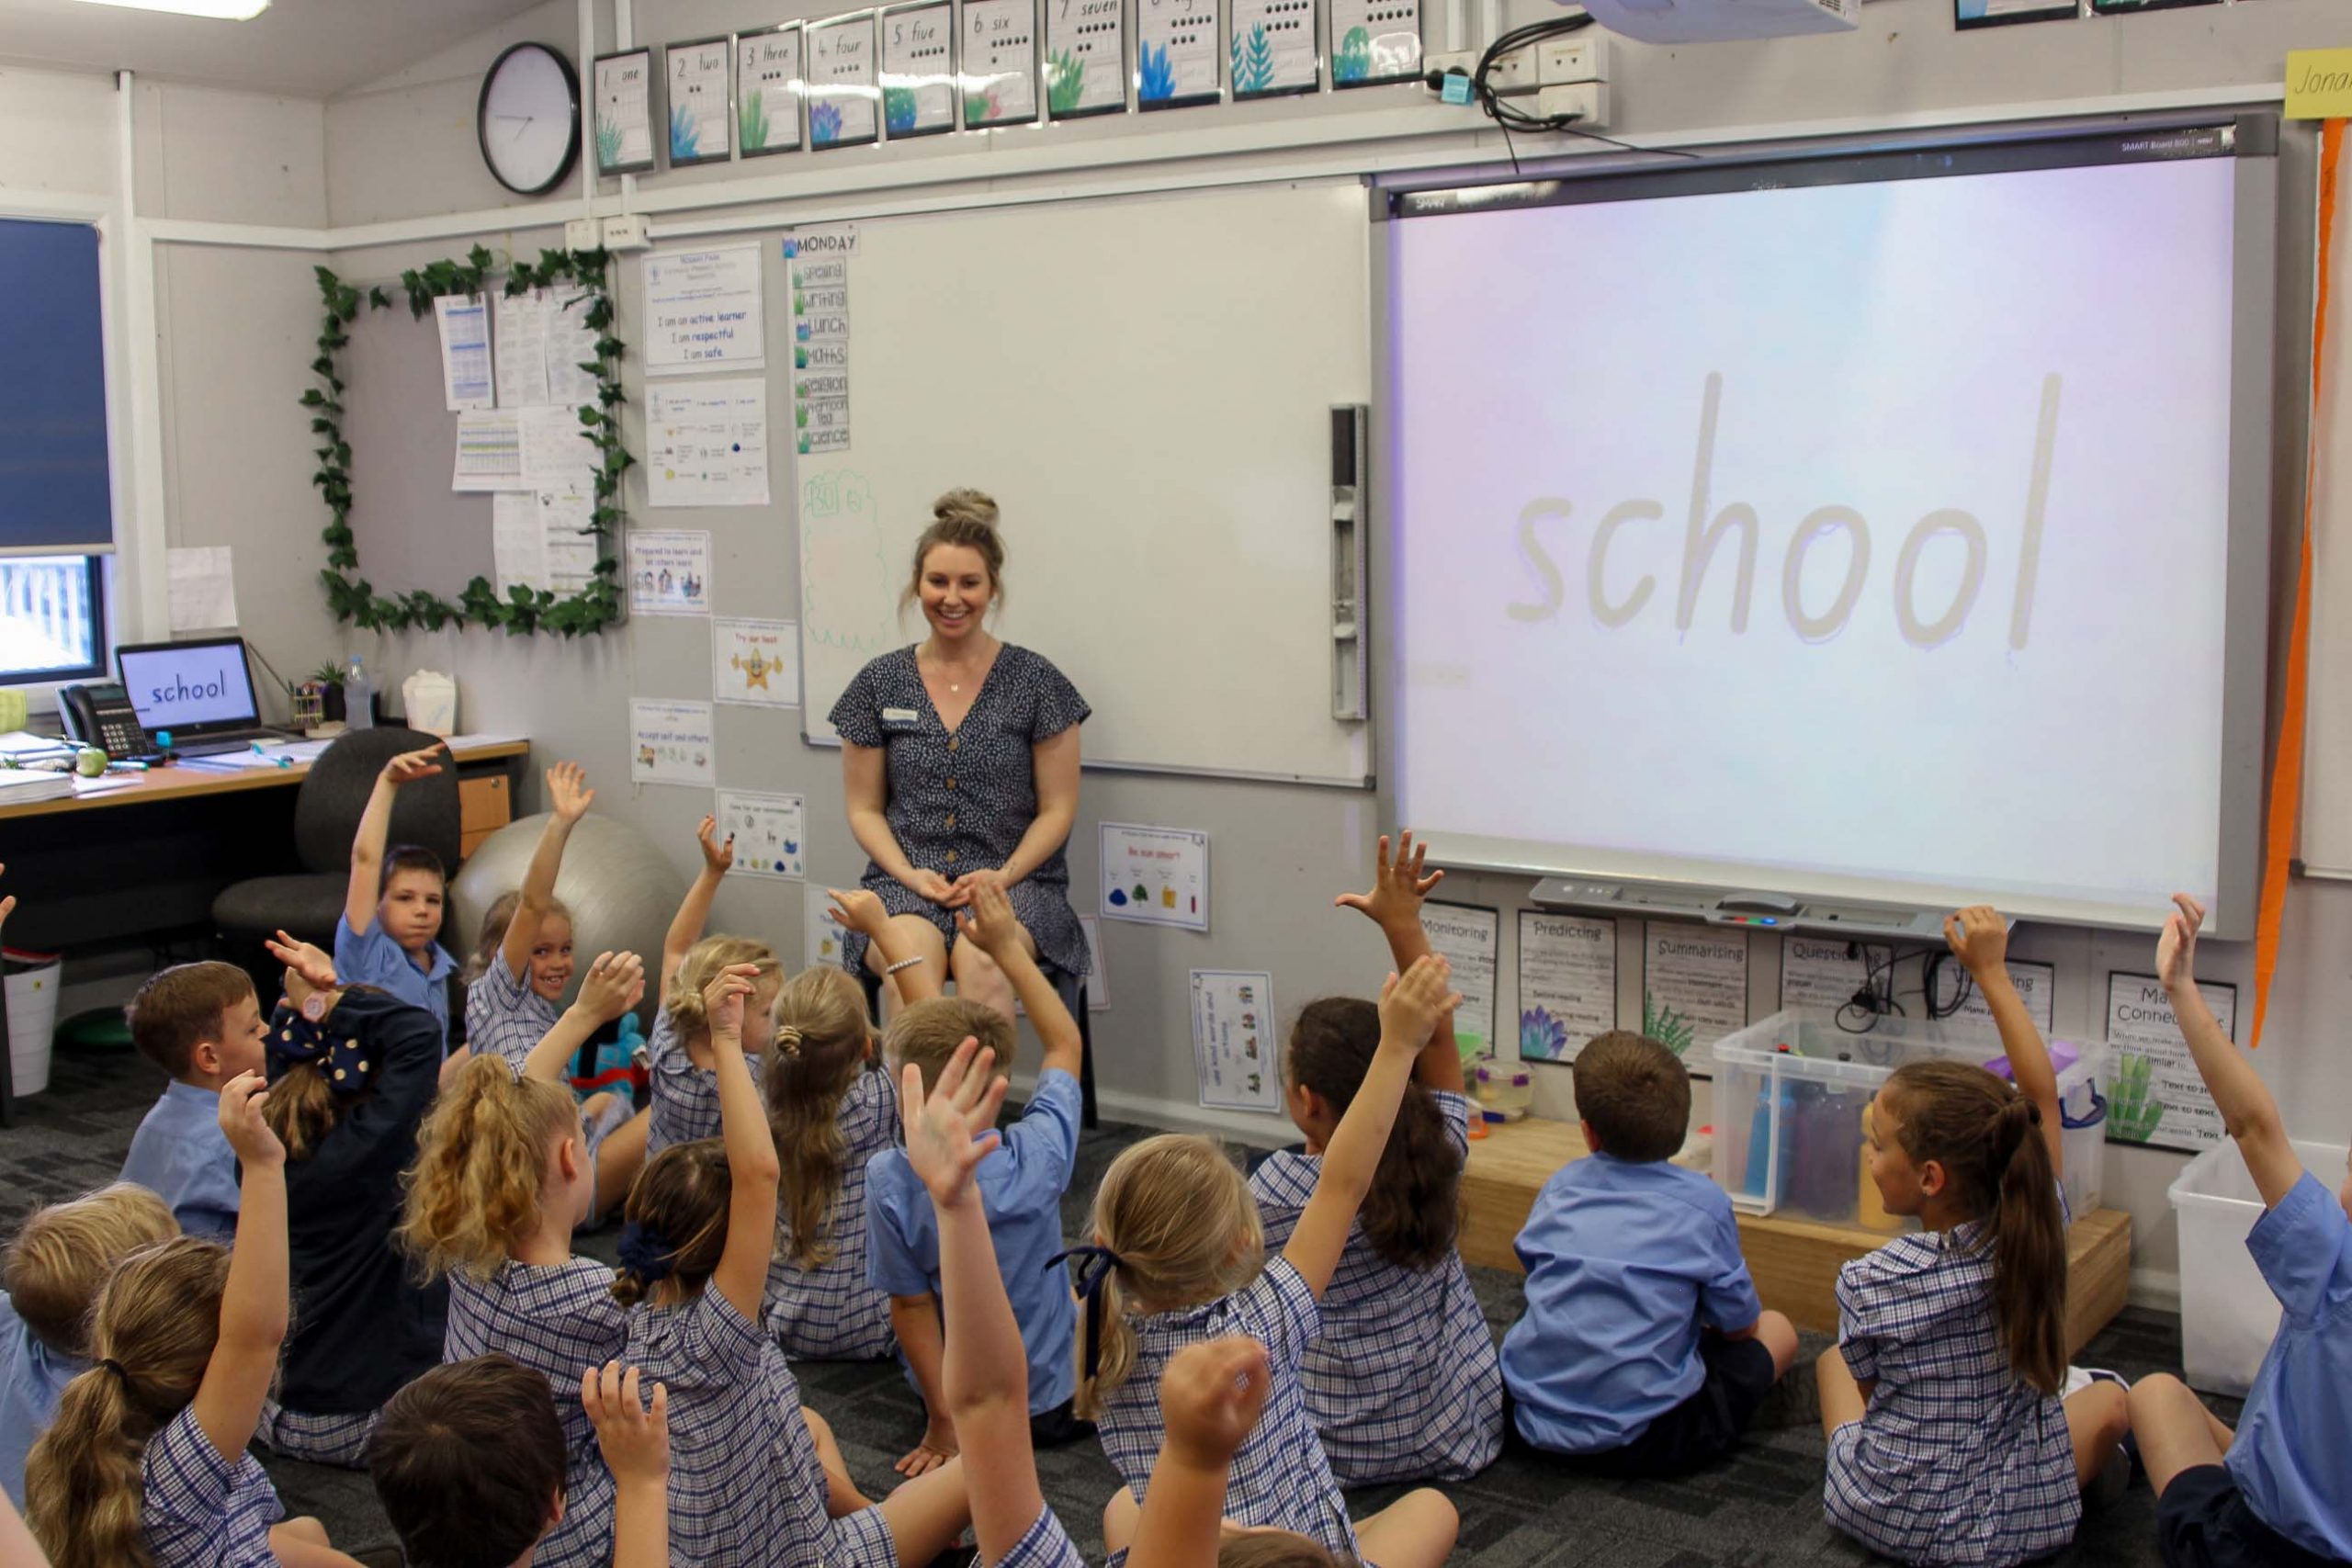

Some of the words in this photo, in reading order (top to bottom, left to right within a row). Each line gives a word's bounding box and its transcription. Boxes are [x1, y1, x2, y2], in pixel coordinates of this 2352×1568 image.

[1081, 1, 1117, 16] seven
[894, 24, 902, 45] 5
[911, 20, 934, 40] five
[974, 13, 982, 33] 6
[992, 15, 1010, 30] six
[747, 47, 754, 66] 3
[763, 43, 789, 61] three
[818, 39, 827, 57] 4
[836, 34, 862, 53] four
[622, 68, 639, 81] one
[677, 58, 686, 77] 2
[699, 52, 718, 71] two
[2295, 64, 2352, 94] Jona
[2122, 141, 2149, 152] SMART
[797, 235, 855, 252] MONDAY
[689, 312, 714, 325] active
[718, 310, 747, 322] learner
[692, 327, 734, 344] respectful
[704, 347, 723, 359] safe
[1507, 372, 2063, 650] school
[153, 669, 226, 704] school
[1421, 919, 1488, 942] Monitoring
[1533, 920, 1602, 942] Predicting
[1658, 940, 1744, 964] Summarising
